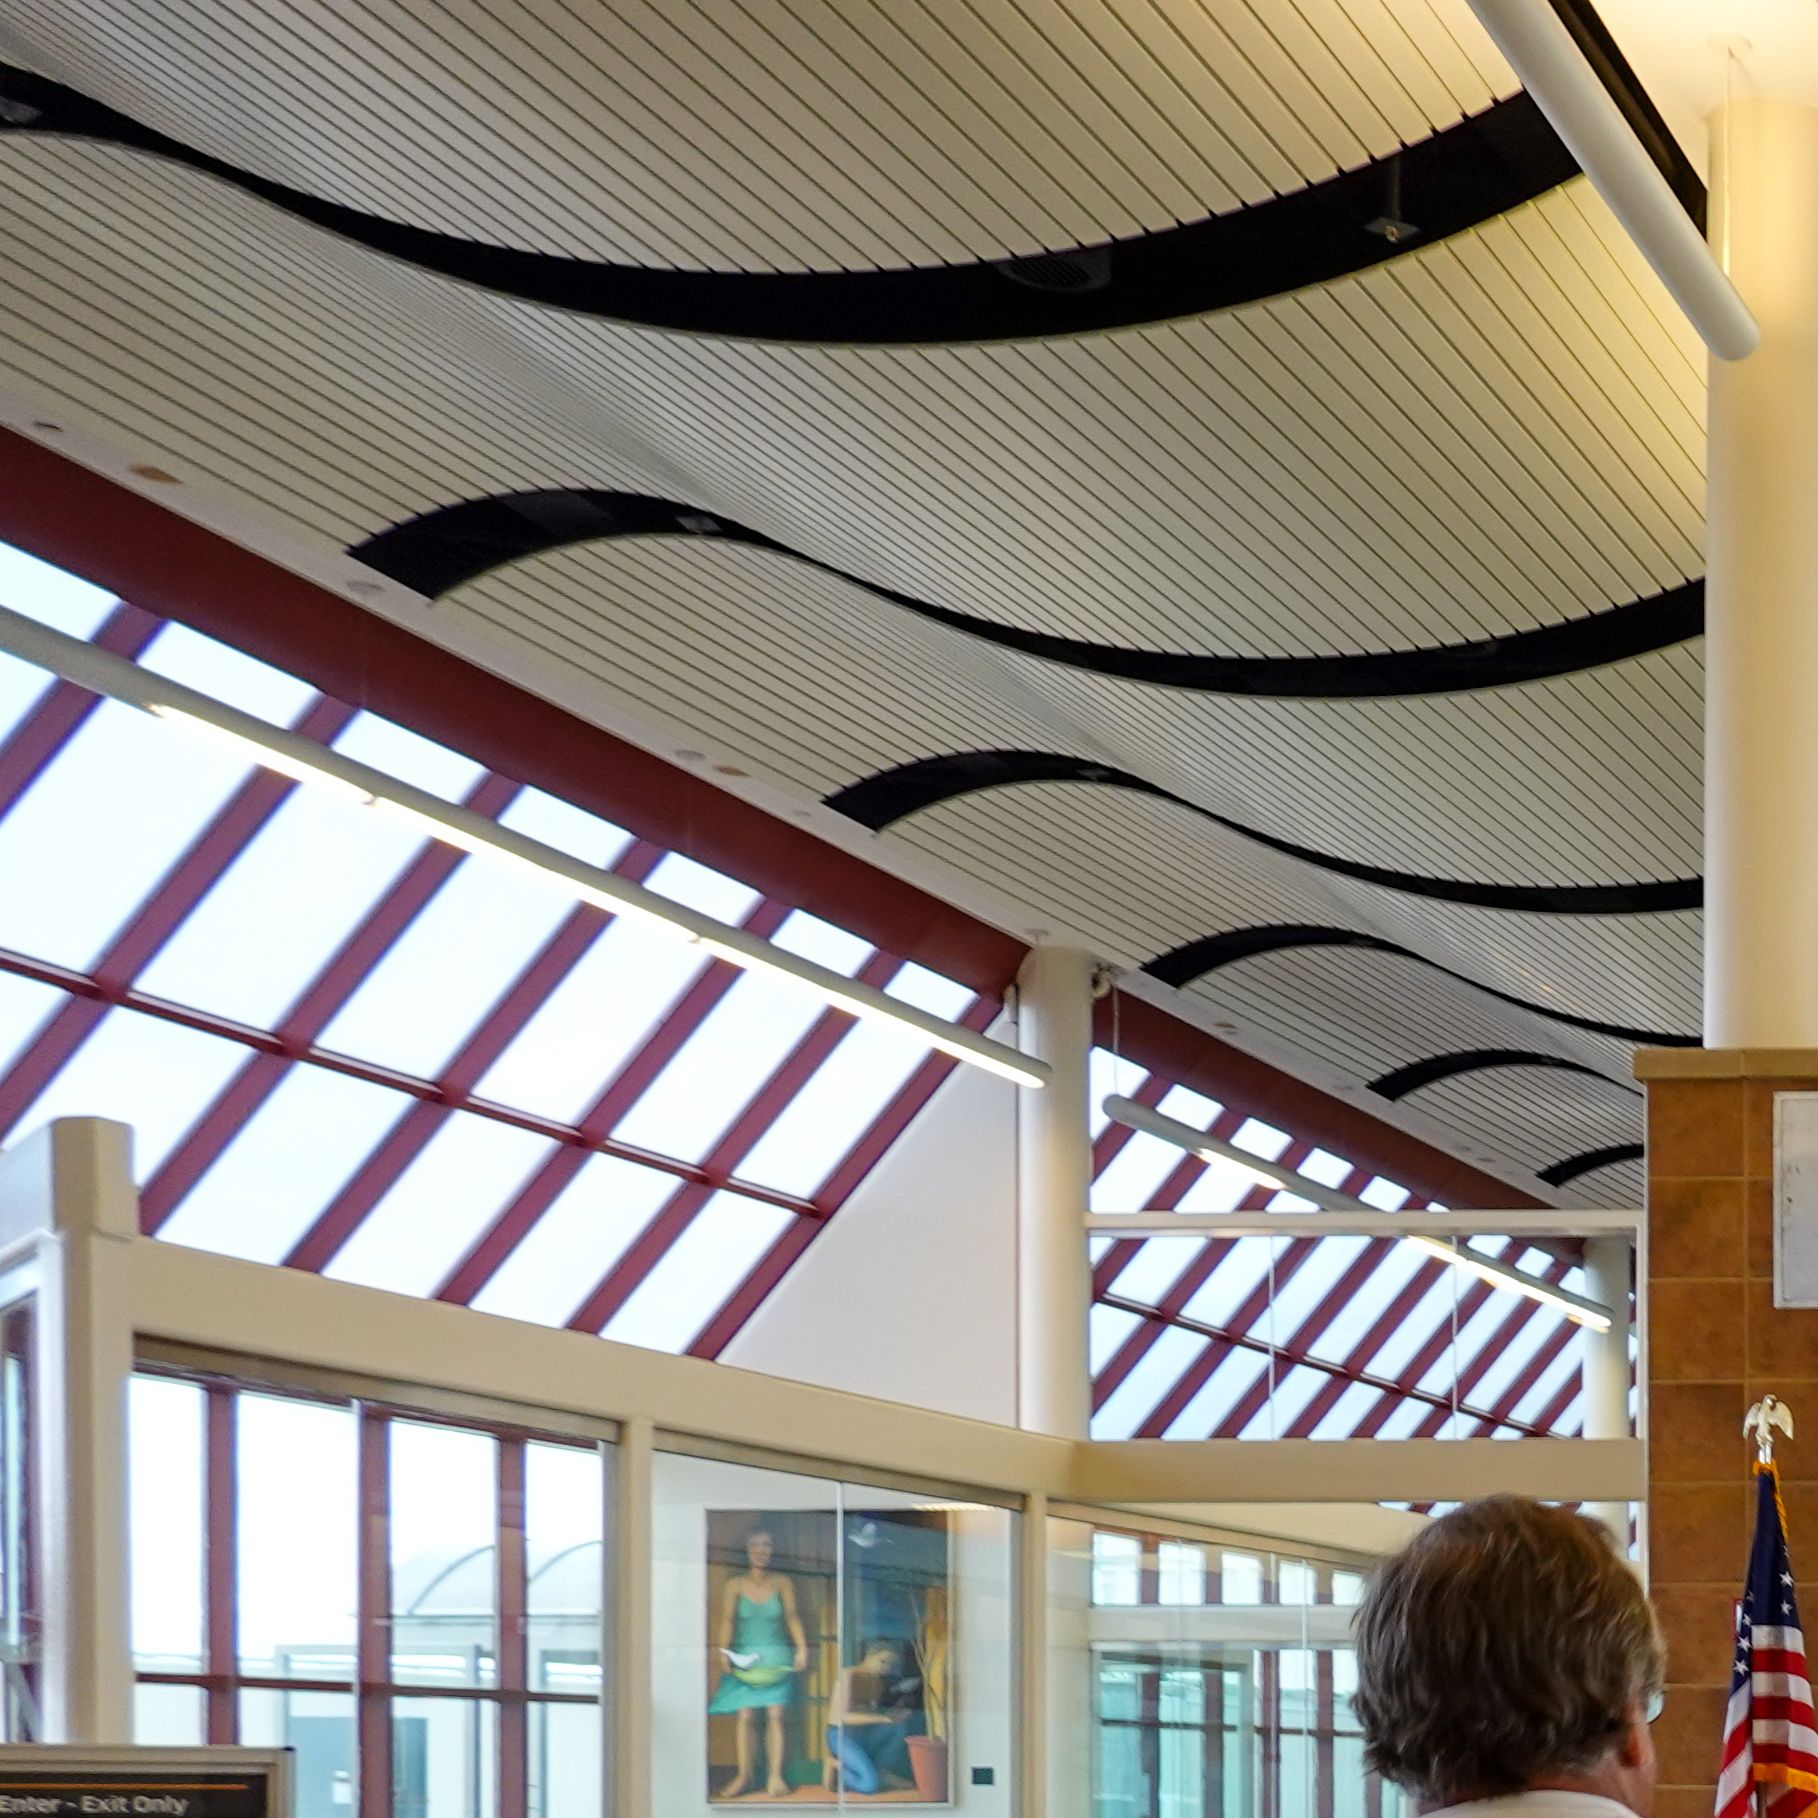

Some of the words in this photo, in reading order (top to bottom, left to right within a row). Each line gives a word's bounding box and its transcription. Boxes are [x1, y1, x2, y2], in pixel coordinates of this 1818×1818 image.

[0, 1795, 61, 1814] Enter
[80, 1795, 130, 1814] Exit
[133, 1795, 190, 1817] Only
